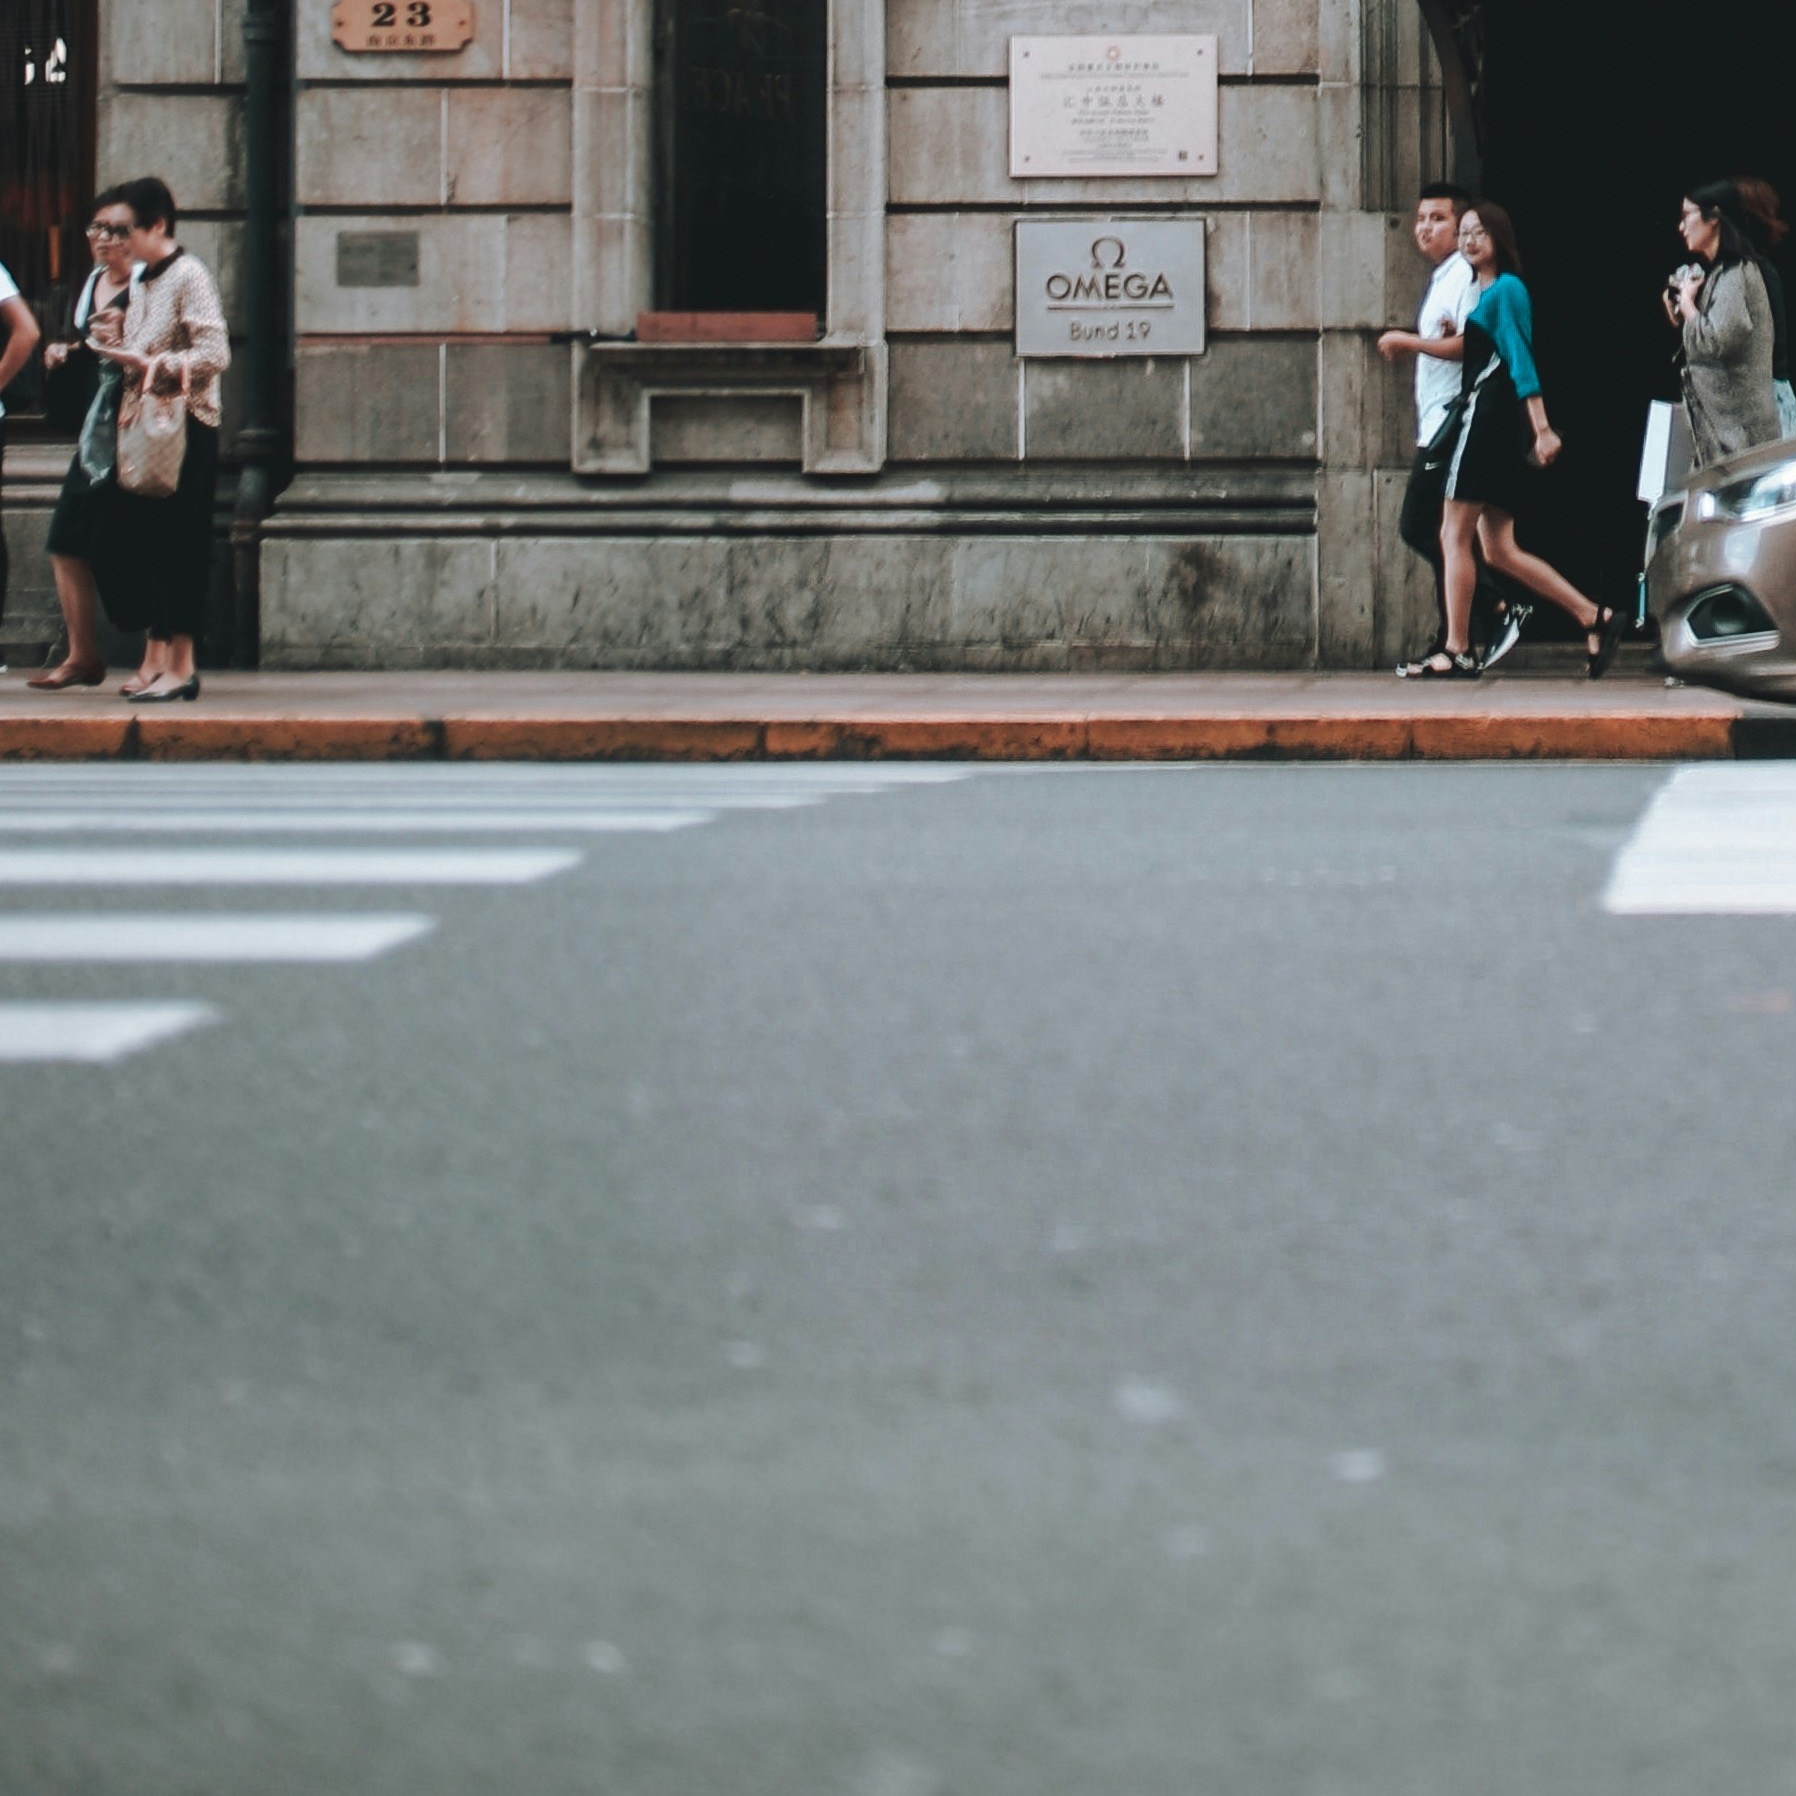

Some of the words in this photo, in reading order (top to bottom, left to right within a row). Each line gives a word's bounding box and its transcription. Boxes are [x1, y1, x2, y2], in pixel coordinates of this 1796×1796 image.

[370, 1, 431, 28] 23
[1046, 272, 1175, 301] OMEGA
[1069, 321, 1120, 341] Bund
[1126, 321, 1152, 341] 19
